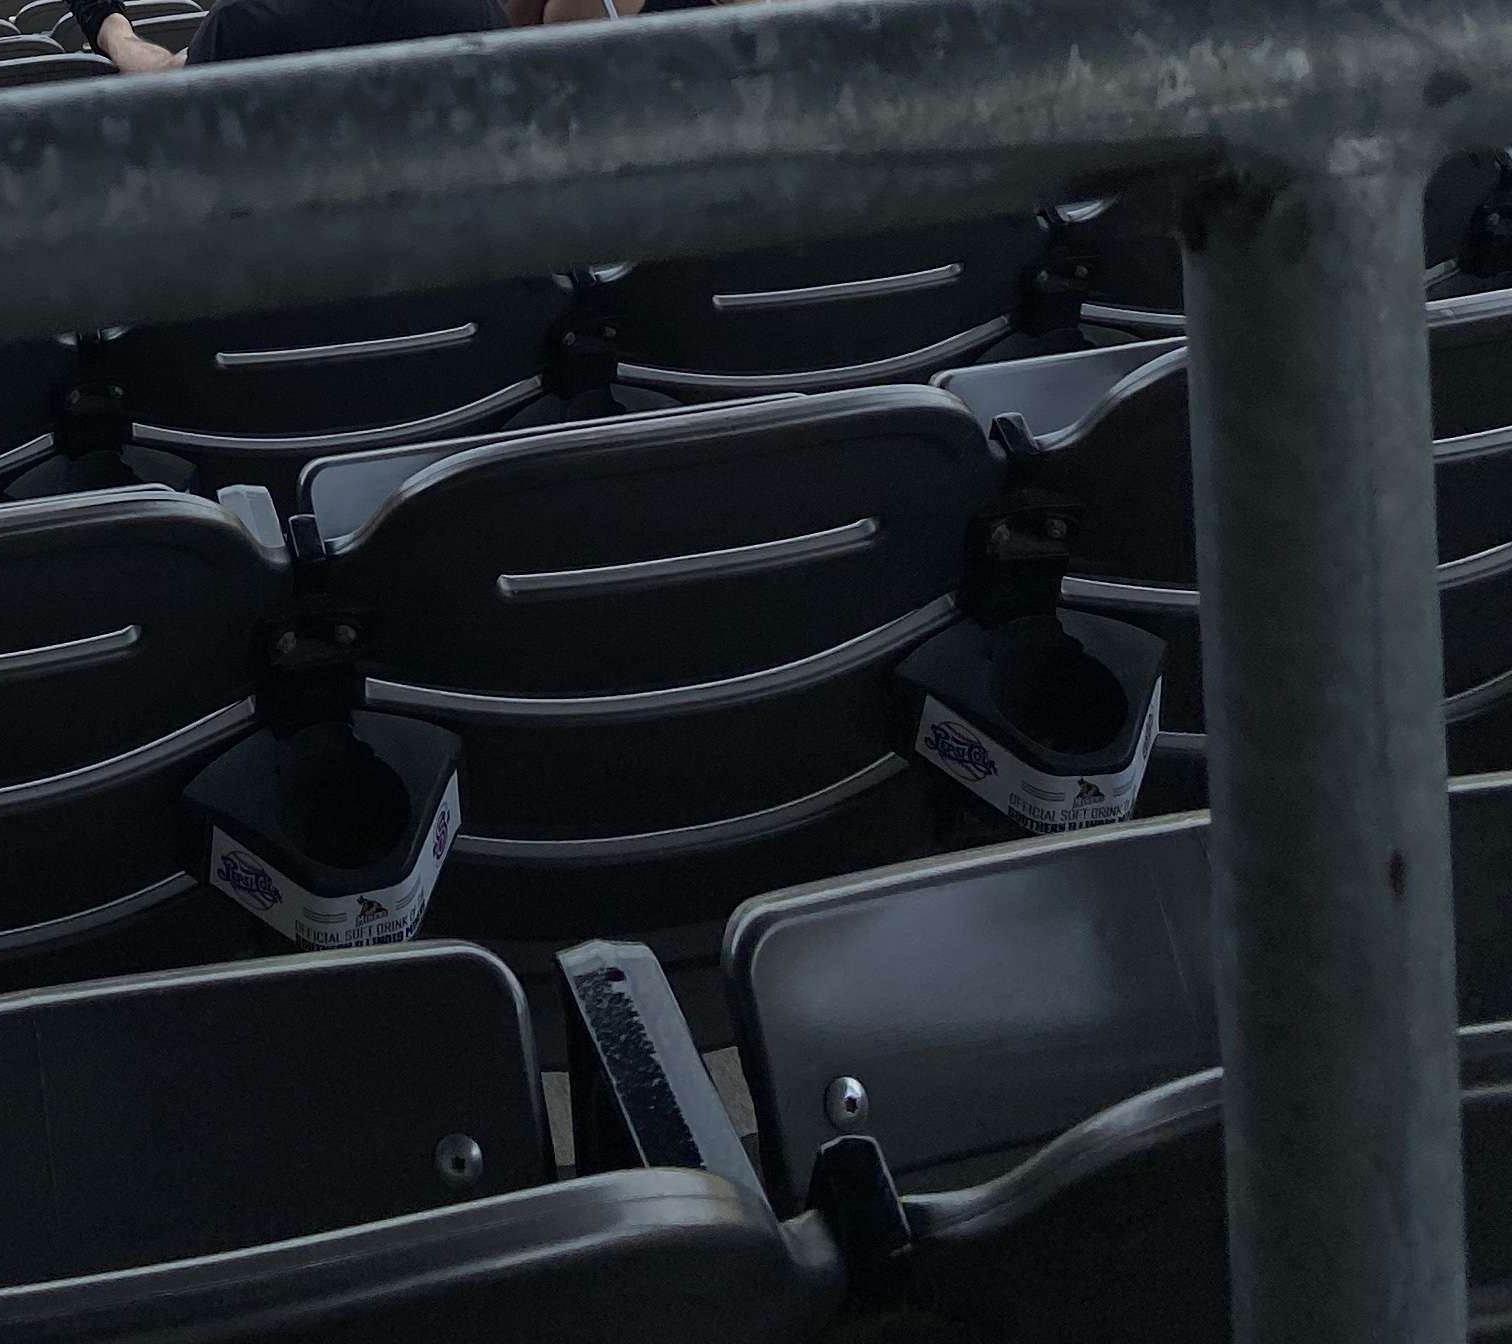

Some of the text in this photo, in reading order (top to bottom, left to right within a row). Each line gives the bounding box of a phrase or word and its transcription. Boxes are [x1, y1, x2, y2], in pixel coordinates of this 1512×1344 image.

[1007, 805, 1066, 834] SOUTHERN
[1008, 792, 1124, 822] OFFICIAL SOFT DRINK
[295, 920, 340, 944] OFFICIAL
[345, 925, 372, 941] SOFT
[376, 917, 409, 934] DRINK
